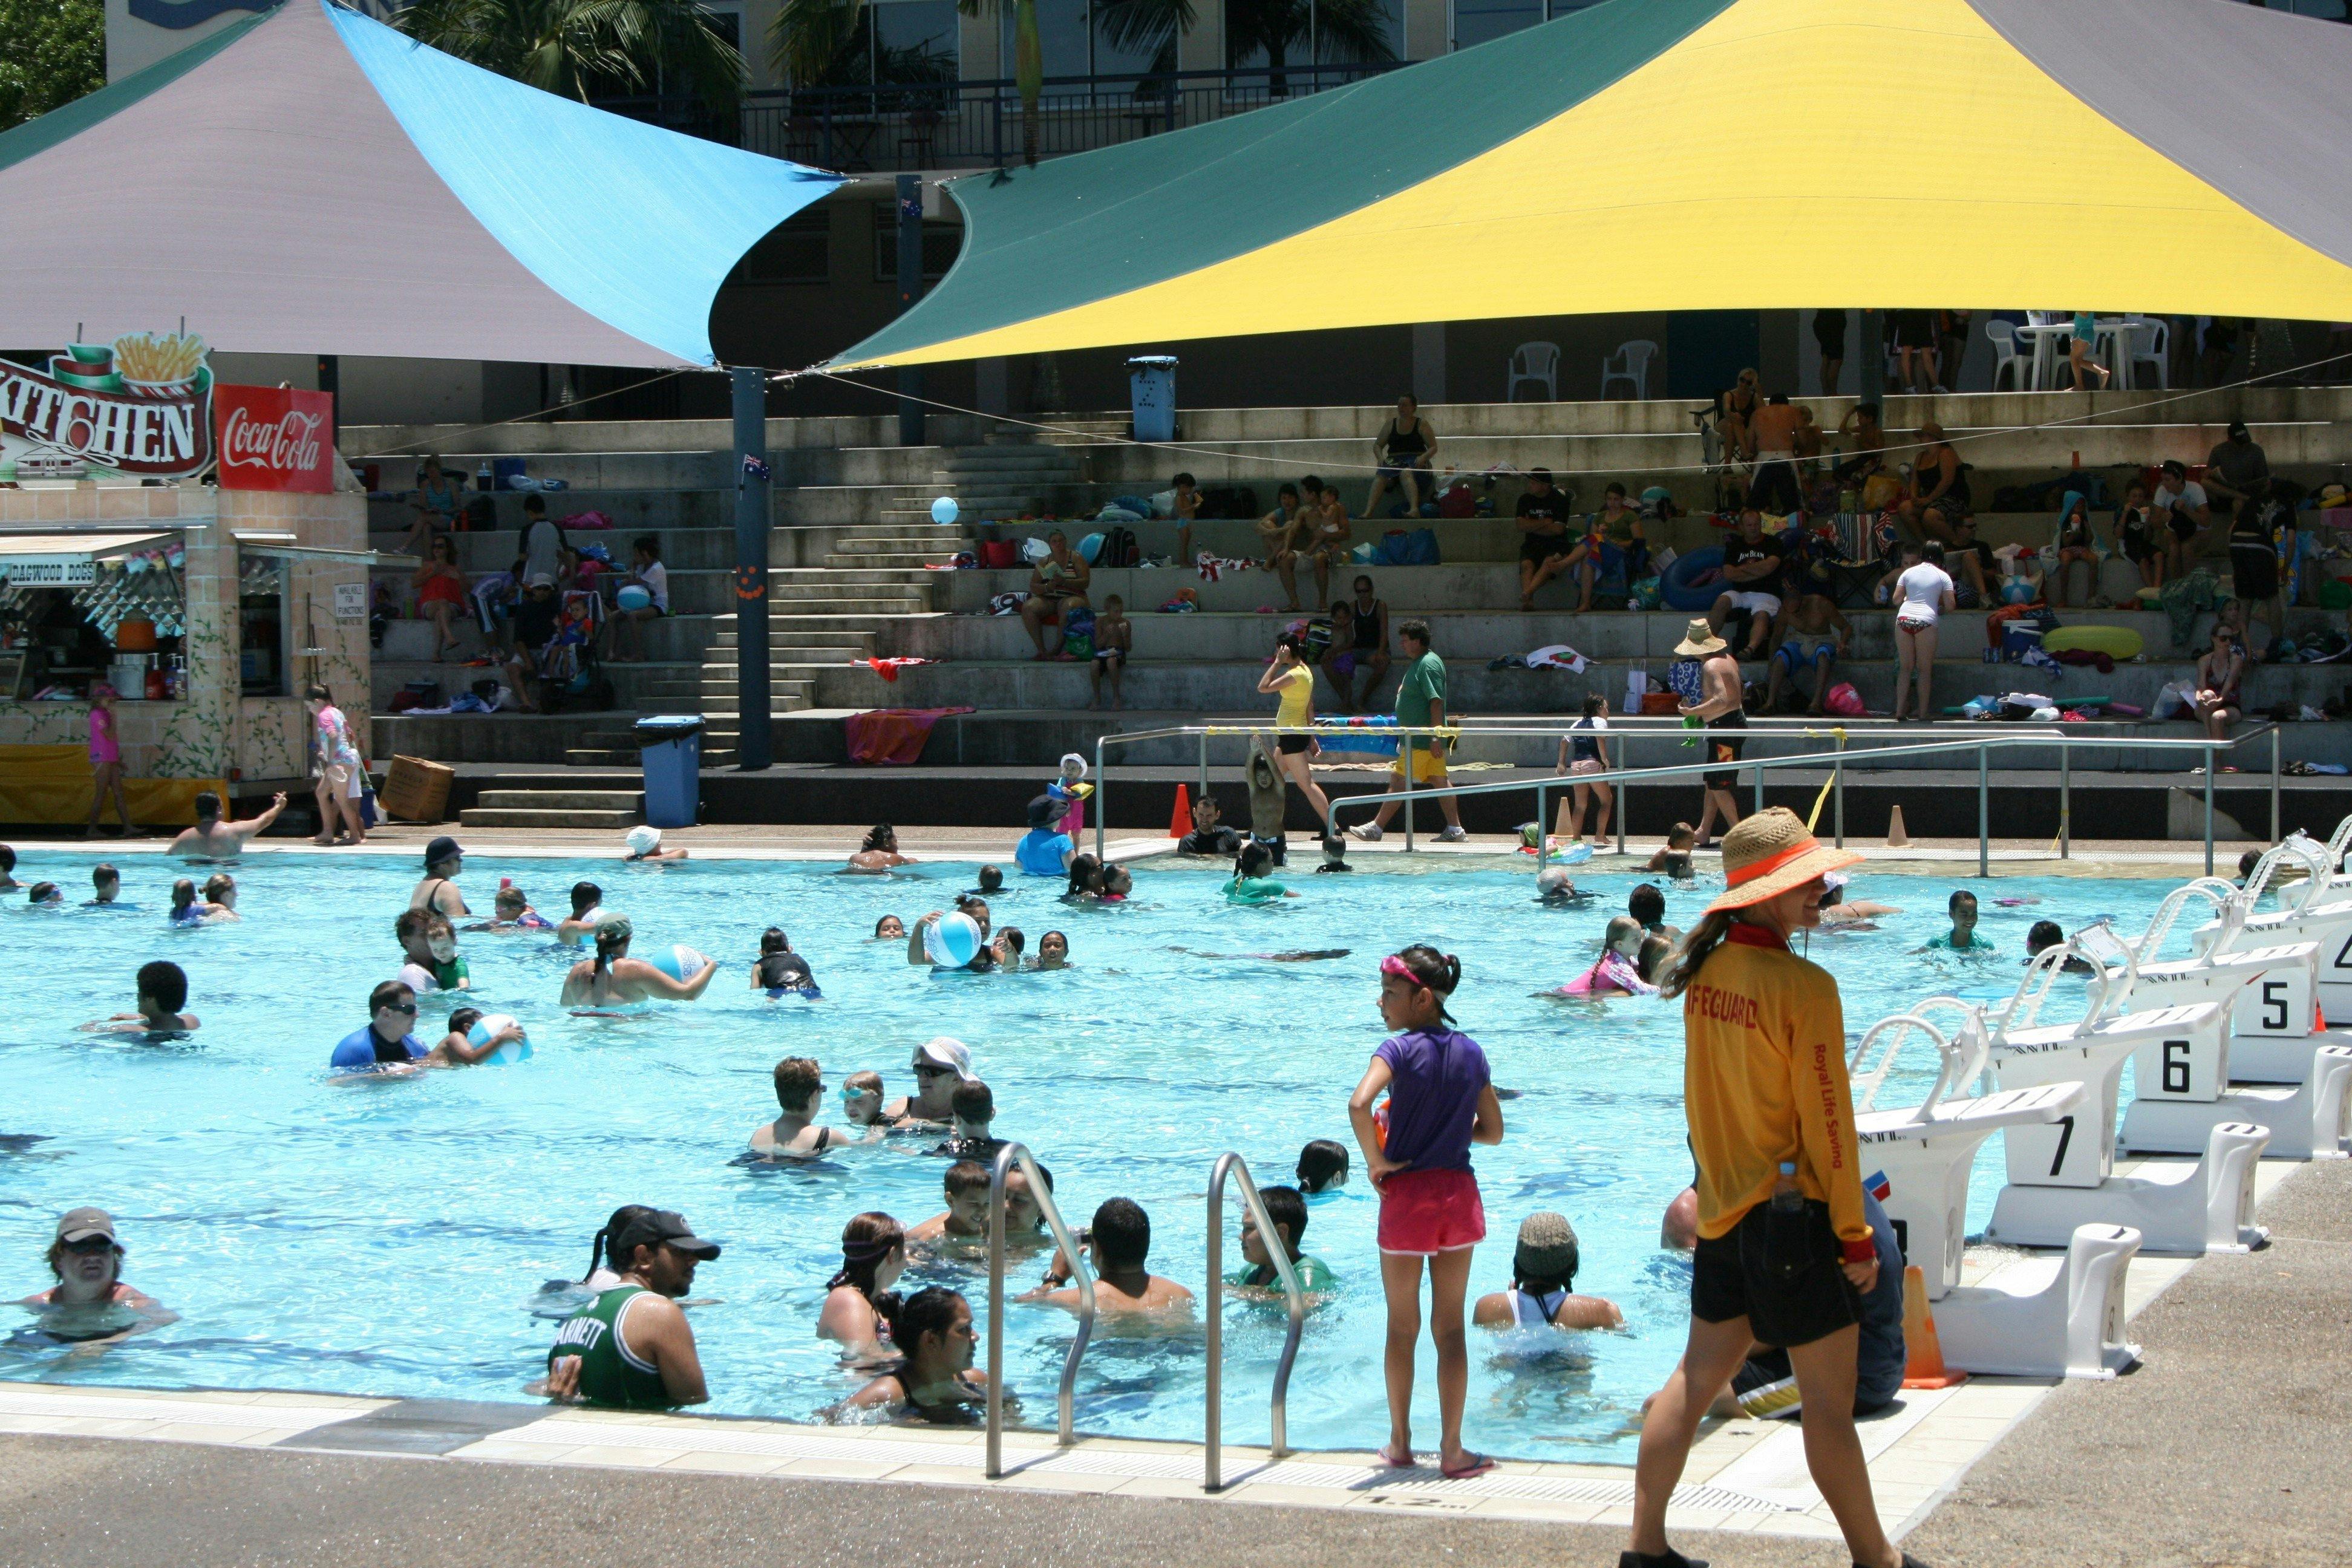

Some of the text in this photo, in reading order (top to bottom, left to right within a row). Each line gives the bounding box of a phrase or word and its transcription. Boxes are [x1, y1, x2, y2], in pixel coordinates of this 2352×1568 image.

[224, 407, 324, 471] Coca-Cola
[12, 564, 93, 581] DAGWOOD DOGS
[1687, 984, 1758, 1029] IFEGUARD
[2262, 981, 2288, 1030] 5
[1814, 1044, 1832, 1086] Royal
[2163, 1040, 2190, 1093] 6
[1821, 1088, 1837, 1117] Life
[2050, 1116, 2074, 1176] 7
[552, 1316, 607, 1350] ARNETT
